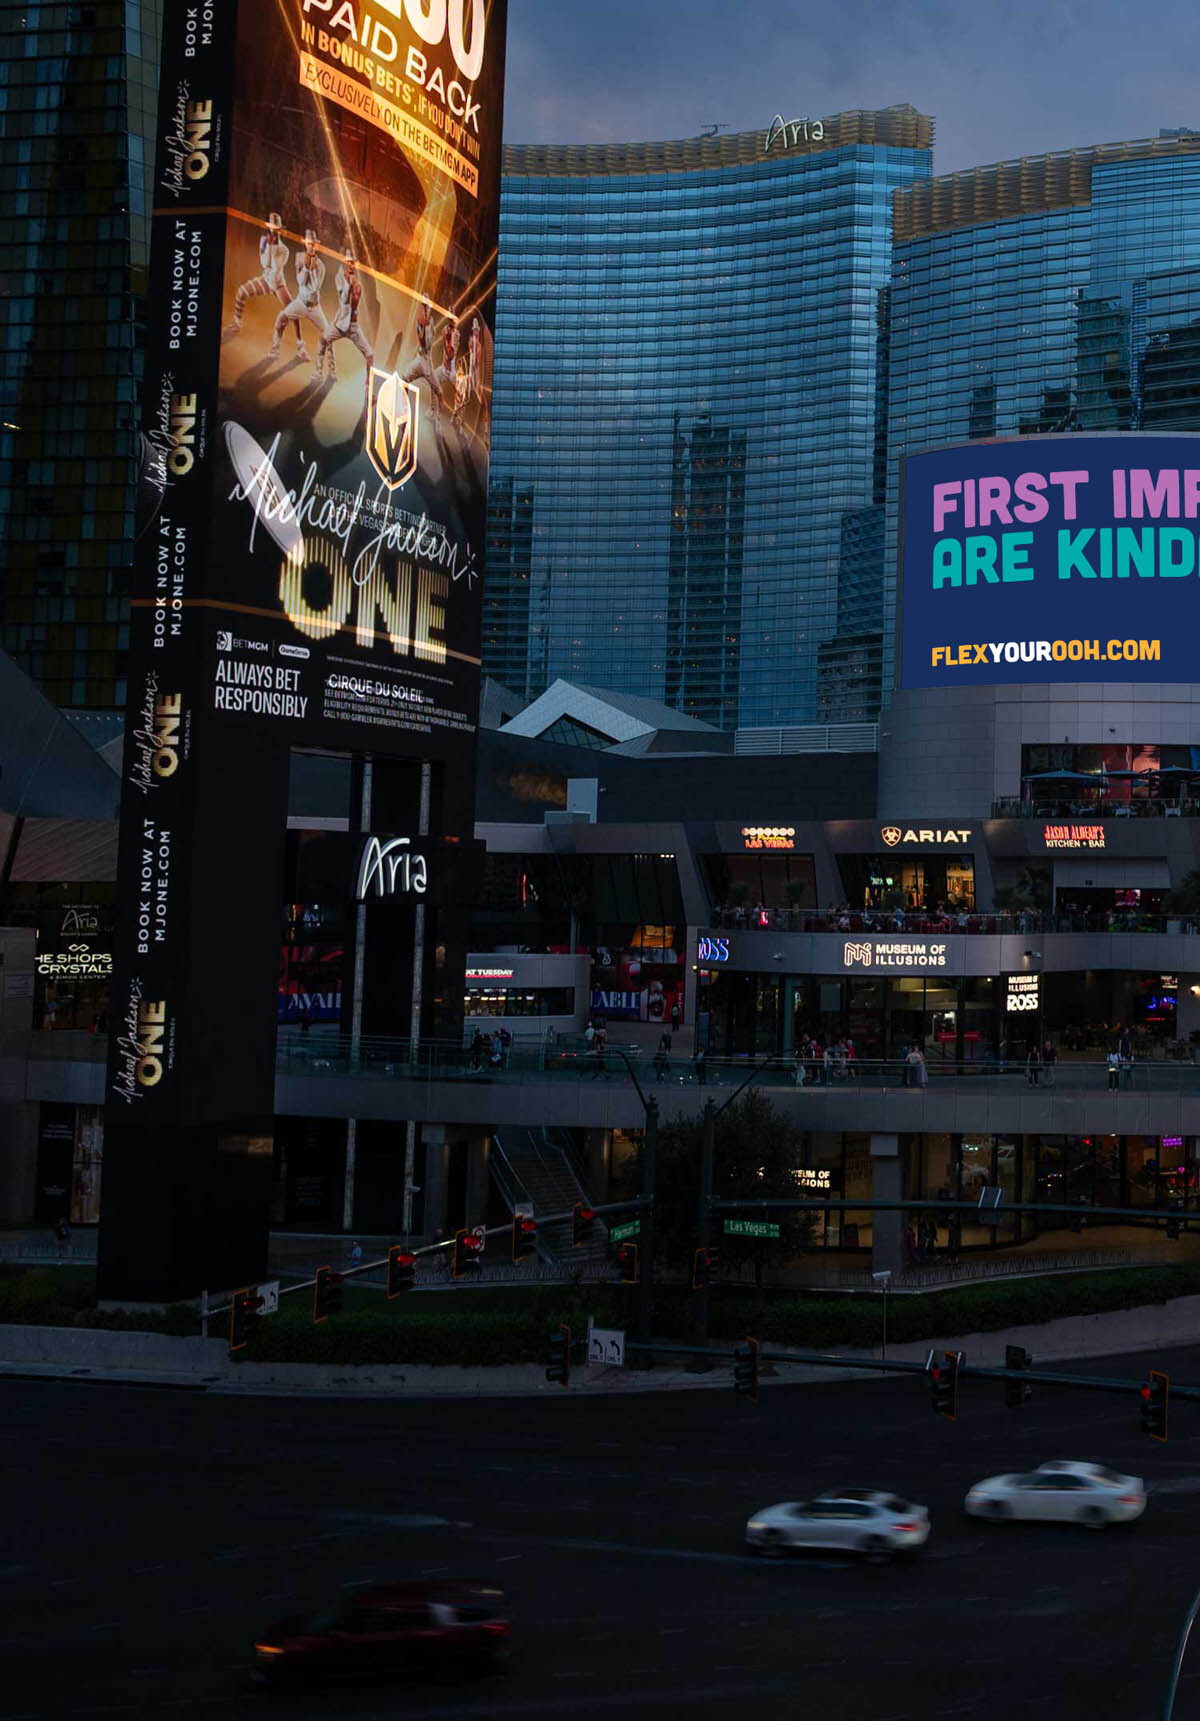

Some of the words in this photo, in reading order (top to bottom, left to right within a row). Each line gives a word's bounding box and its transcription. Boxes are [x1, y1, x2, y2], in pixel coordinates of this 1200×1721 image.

[185, 8, 198, 57] BOOK
[301, 19, 315, 46] IN
[318, 29, 375, 82] BONUS
[418, 94, 428, 118] IF
[427, 100, 444, 130] YOU
[405, 45, 482, 134] BACK
[184, 100, 213, 180] ONE
[305, 62, 383, 119] EXCLUSIVELY
[384, 108, 400, 132] ON
[402, 119, 421, 145] THE
[423, 134, 460, 176] BETMGM
[461, 163, 477, 187] APP
[765, 114, 824, 151] Aria
[160, 147, 191, 198] Michael
[176, 220, 187, 240] AT
[173, 249, 185, 290] NOW
[186, 231, 202, 336] MJONE.COM
[169, 299, 182, 349] BOOK
[150, 378, 179, 447] Jackson
[168, 393, 197, 475] ONE
[144, 440, 176, 494] Michael
[228, 432, 366, 557] Michael
[353, 475, 469, 586] Jackson
[313, 483, 328, 497] AN
[933, 470, 1089, 533] FIRST
[160, 516, 171, 536] AT
[359, 513, 383, 532] VEGAS
[157, 545, 169, 588] NOW
[171, 527, 186, 635] MJONE.COM
[932, 531, 1034, 589] ARE
[279, 535, 449, 664] ONE
[154, 597, 167, 647] BOOK
[233, 638, 268, 651] BETMGM
[931, 639, 1161, 667] FLEXYOUROOH.COM
[215, 659, 273, 688] ALWAYS
[275, 667, 301, 692] BET
[328, 674, 373, 698] CIRQUE
[374, 682, 390, 697] DU
[391, 686, 424, 703] SOLEIL
[215, 685, 308, 718] RESPONSIBLY
[154, 693, 181, 777] ONE
[129, 744, 159, 794] Michael
[144, 818, 155, 839] AT
[745, 839, 763, 848] LAS
[903, 830, 971, 843] ARIAT
[1044, 824, 1069, 840] JASON
[1046, 840, 1080, 848] KITCHEN
[1088, 840, 1105, 848] BAR
[141, 849, 153, 892] NOW
[155, 831, 171, 941] MJONE.COM
[357, 836, 428, 900] Aria
[62, 910, 98, 931] Aria
[138, 901, 150, 953] BOOK
[56, 953, 112, 964] SHOPS
[876, 944, 926, 954] MUSEUM
[930, 944, 946, 954] OF
[876, 955, 946, 966] ILLUSIONS
[1007, 993, 1039, 1011] ROSS
[1008, 983, 1038, 991] ILLUSIONS
[117, 984, 150, 1056] Jackson
[137, 1000, 166, 1087] ONE
[112, 1050, 143, 1104] Michael
[818, 1170, 830, 1179] OF
[730, 1219, 743, 1232] Las
[744, 1220, 767, 1236] Vegas
